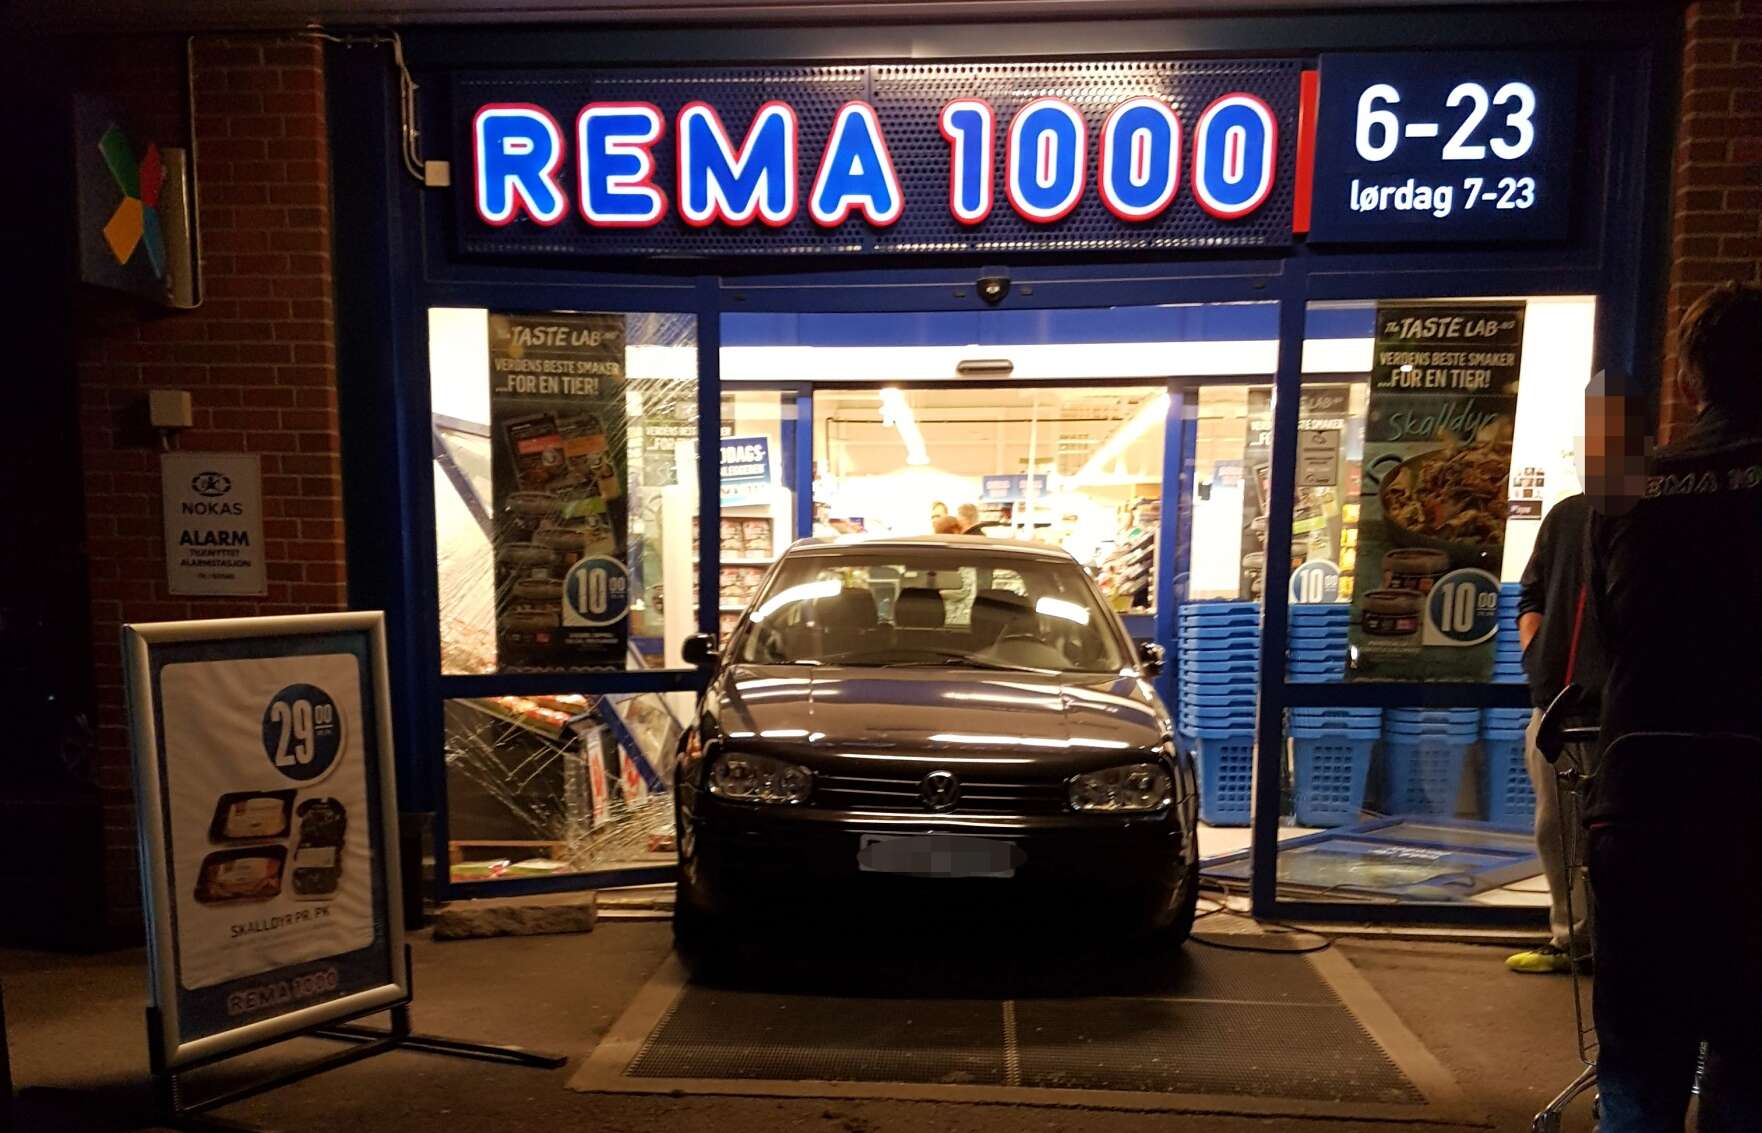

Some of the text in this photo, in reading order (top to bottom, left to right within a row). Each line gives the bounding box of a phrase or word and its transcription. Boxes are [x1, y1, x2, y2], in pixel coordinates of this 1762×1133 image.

[1355, 82, 1536, 161] 6-23
[472, 92, 1276, 228] REMA 1000
[1350, 177, 1536, 217] lørdag 7-23
[511, 326, 569, 346] TASTE
[571, 330, 600, 346] LAB
[1400, 317, 1464, 339] TASTE
[1464, 320, 1498, 337] LAB
[543, 360, 575, 373] BESTE
[1380, 351, 1515, 367] VERDENS BESTE SMAKER
[540, 376, 557, 393] EN
[563, 377, 599, 394] TIER!
[1425, 369, 1447, 388] EN
[1452, 369, 1491, 388] TIER!
[1388, 398, 1498, 446] Skalldyr
[182, 502, 243, 516] NOKAS
[180, 530, 250, 546] ALARM
[576, 568, 608, 614] 10
[1299, 568, 1324, 604] 10
[1441, 582, 1477, 633] 10
[271, 699, 315, 767] 29
[228, 980, 291, 1016] REMA
